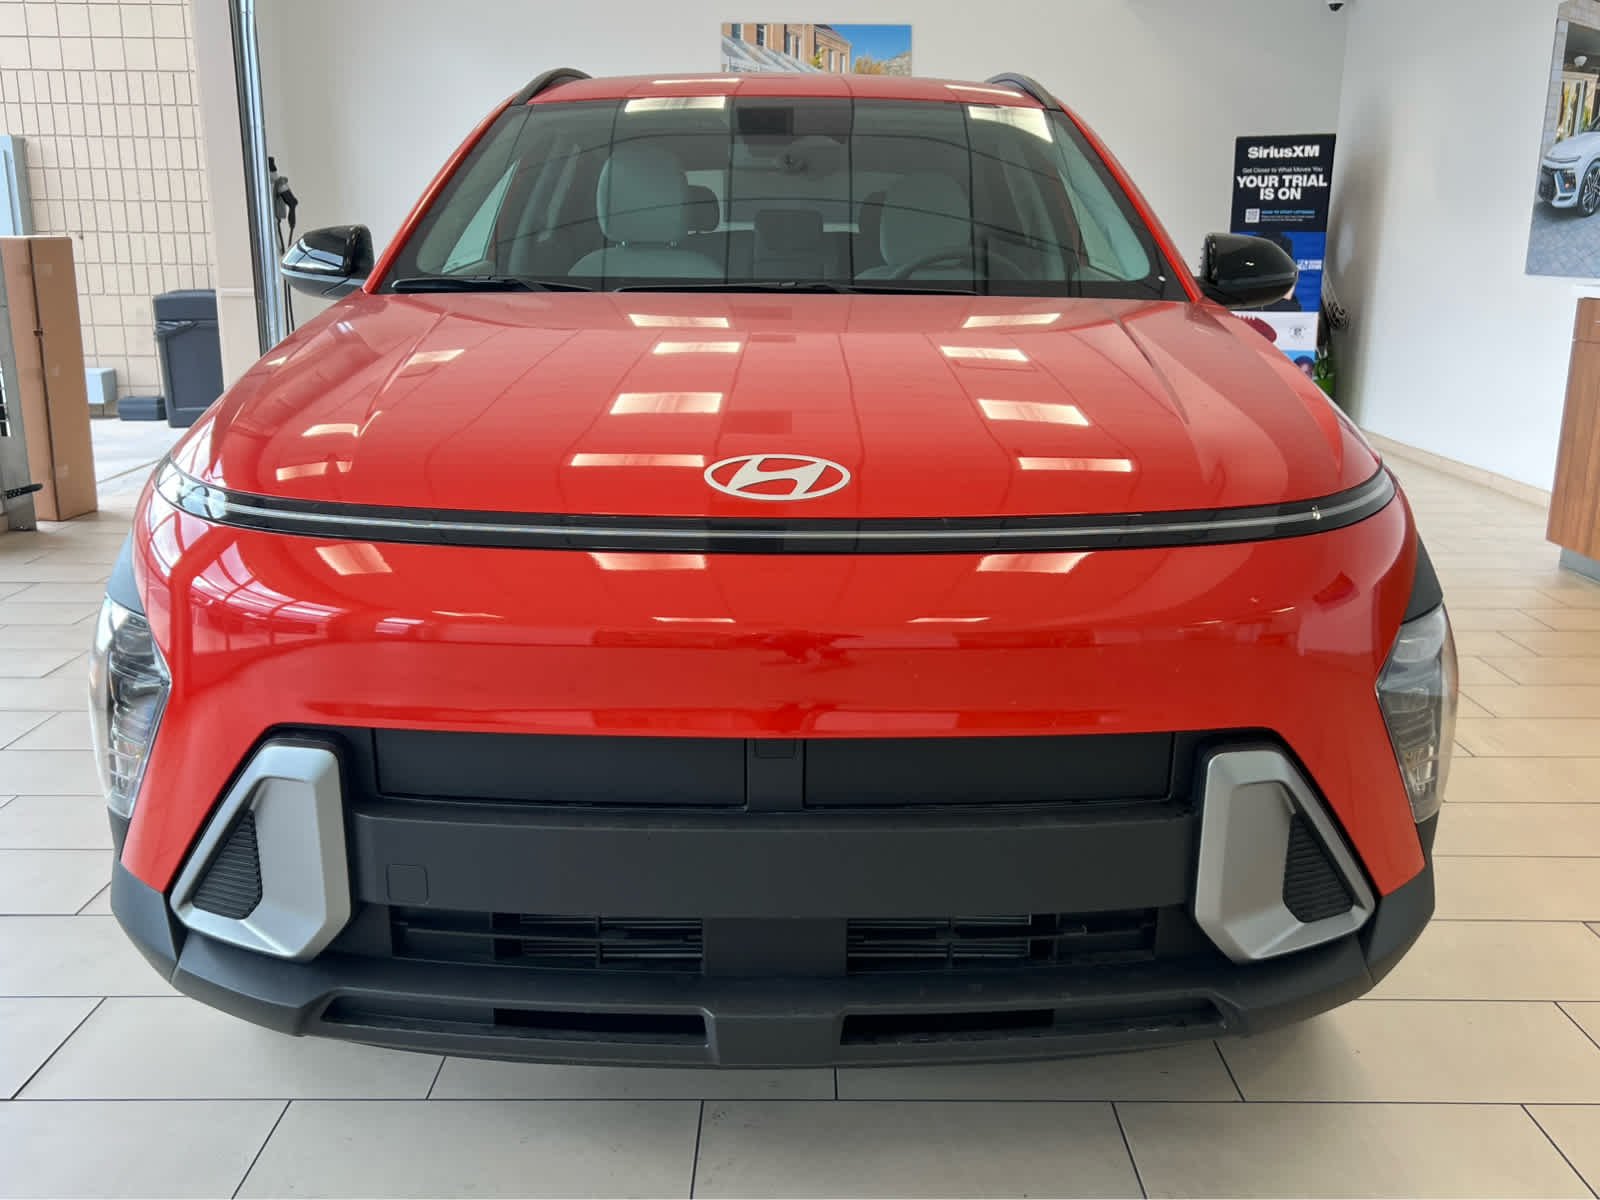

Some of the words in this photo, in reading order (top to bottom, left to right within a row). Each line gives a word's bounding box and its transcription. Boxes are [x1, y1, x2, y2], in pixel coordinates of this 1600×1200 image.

[1247, 145, 1320, 159] SiriusXM
[1236, 175, 1279, 188] YOUR
[1282, 174, 1328, 187] TRIAL
[1260, 188, 1275, 200] IS
[1277, 187, 1302, 200] ON
